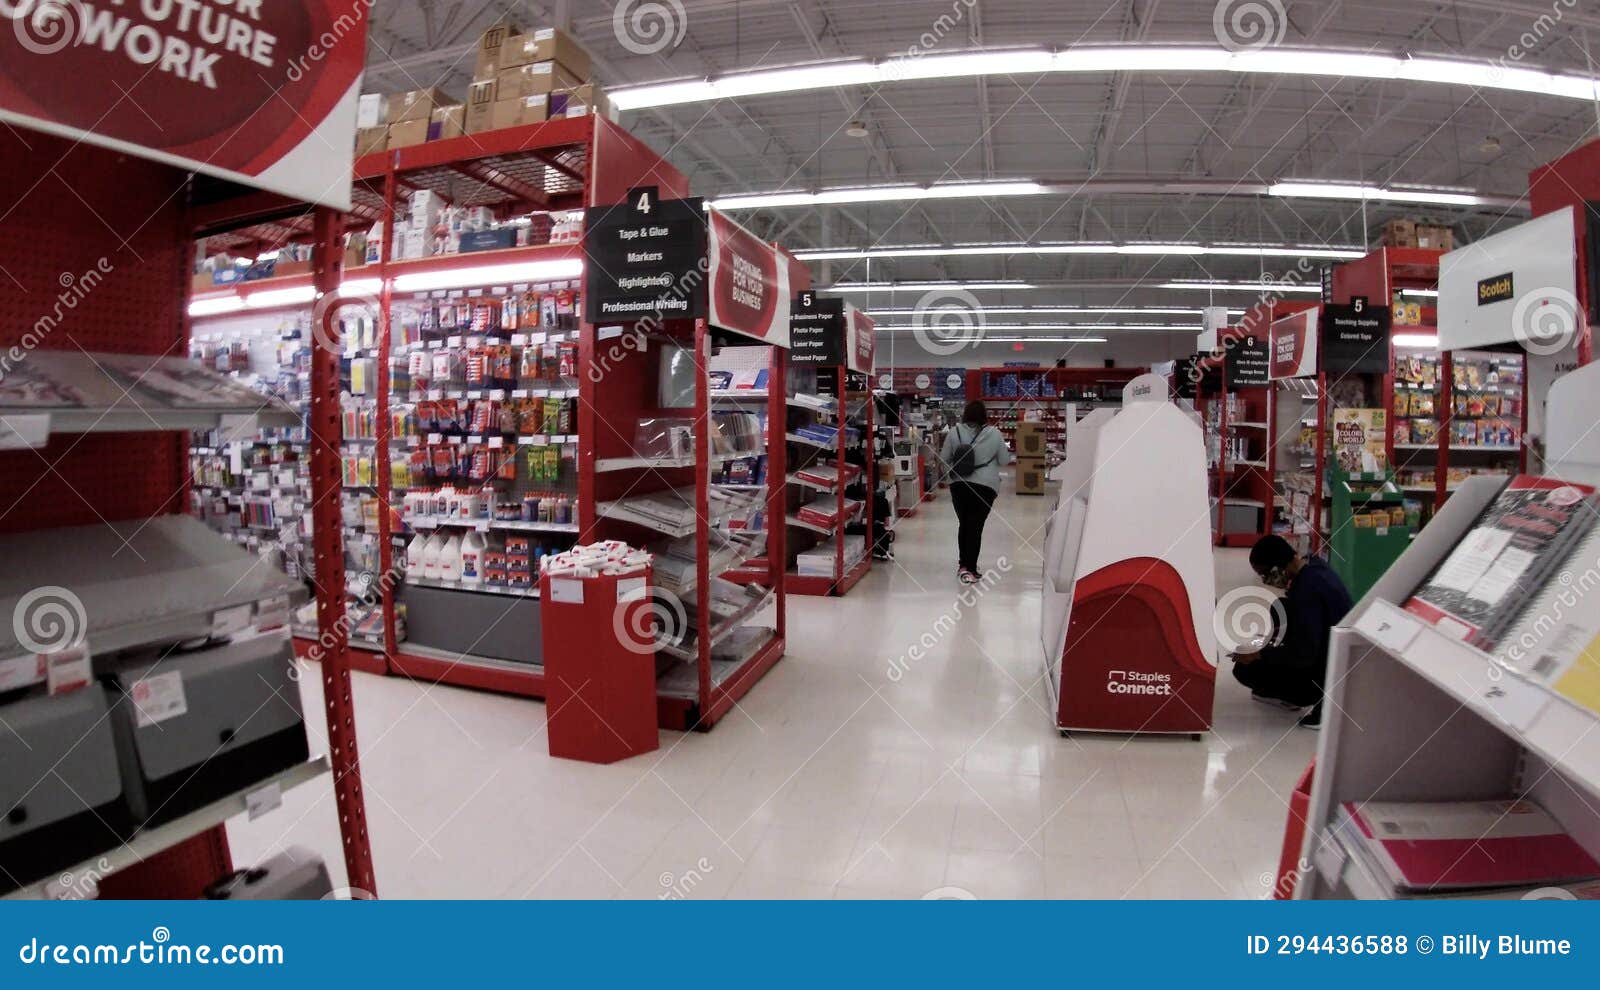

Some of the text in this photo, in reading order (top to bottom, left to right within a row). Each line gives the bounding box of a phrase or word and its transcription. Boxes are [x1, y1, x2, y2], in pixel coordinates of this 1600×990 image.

[79, 2, 222, 89] WORK
[636, 192, 651, 213] 4
[619, 227, 669, 240] Tape & Glue
[627, 252, 663, 263] Markers
[733, 269, 764, 297] FOR YOUR
[1480, 278, 1511, 299] Scotch
[732, 286, 761, 311] BUSINESS
[803, 294, 812, 307] 5
[602, 299, 688, 313] Professional Writing
[1354, 299, 1363, 313] 5
[1247, 337, 1254, 347] 6
[1128, 671, 1171, 683] Staples
[1107, 681, 1172, 696] Connect
